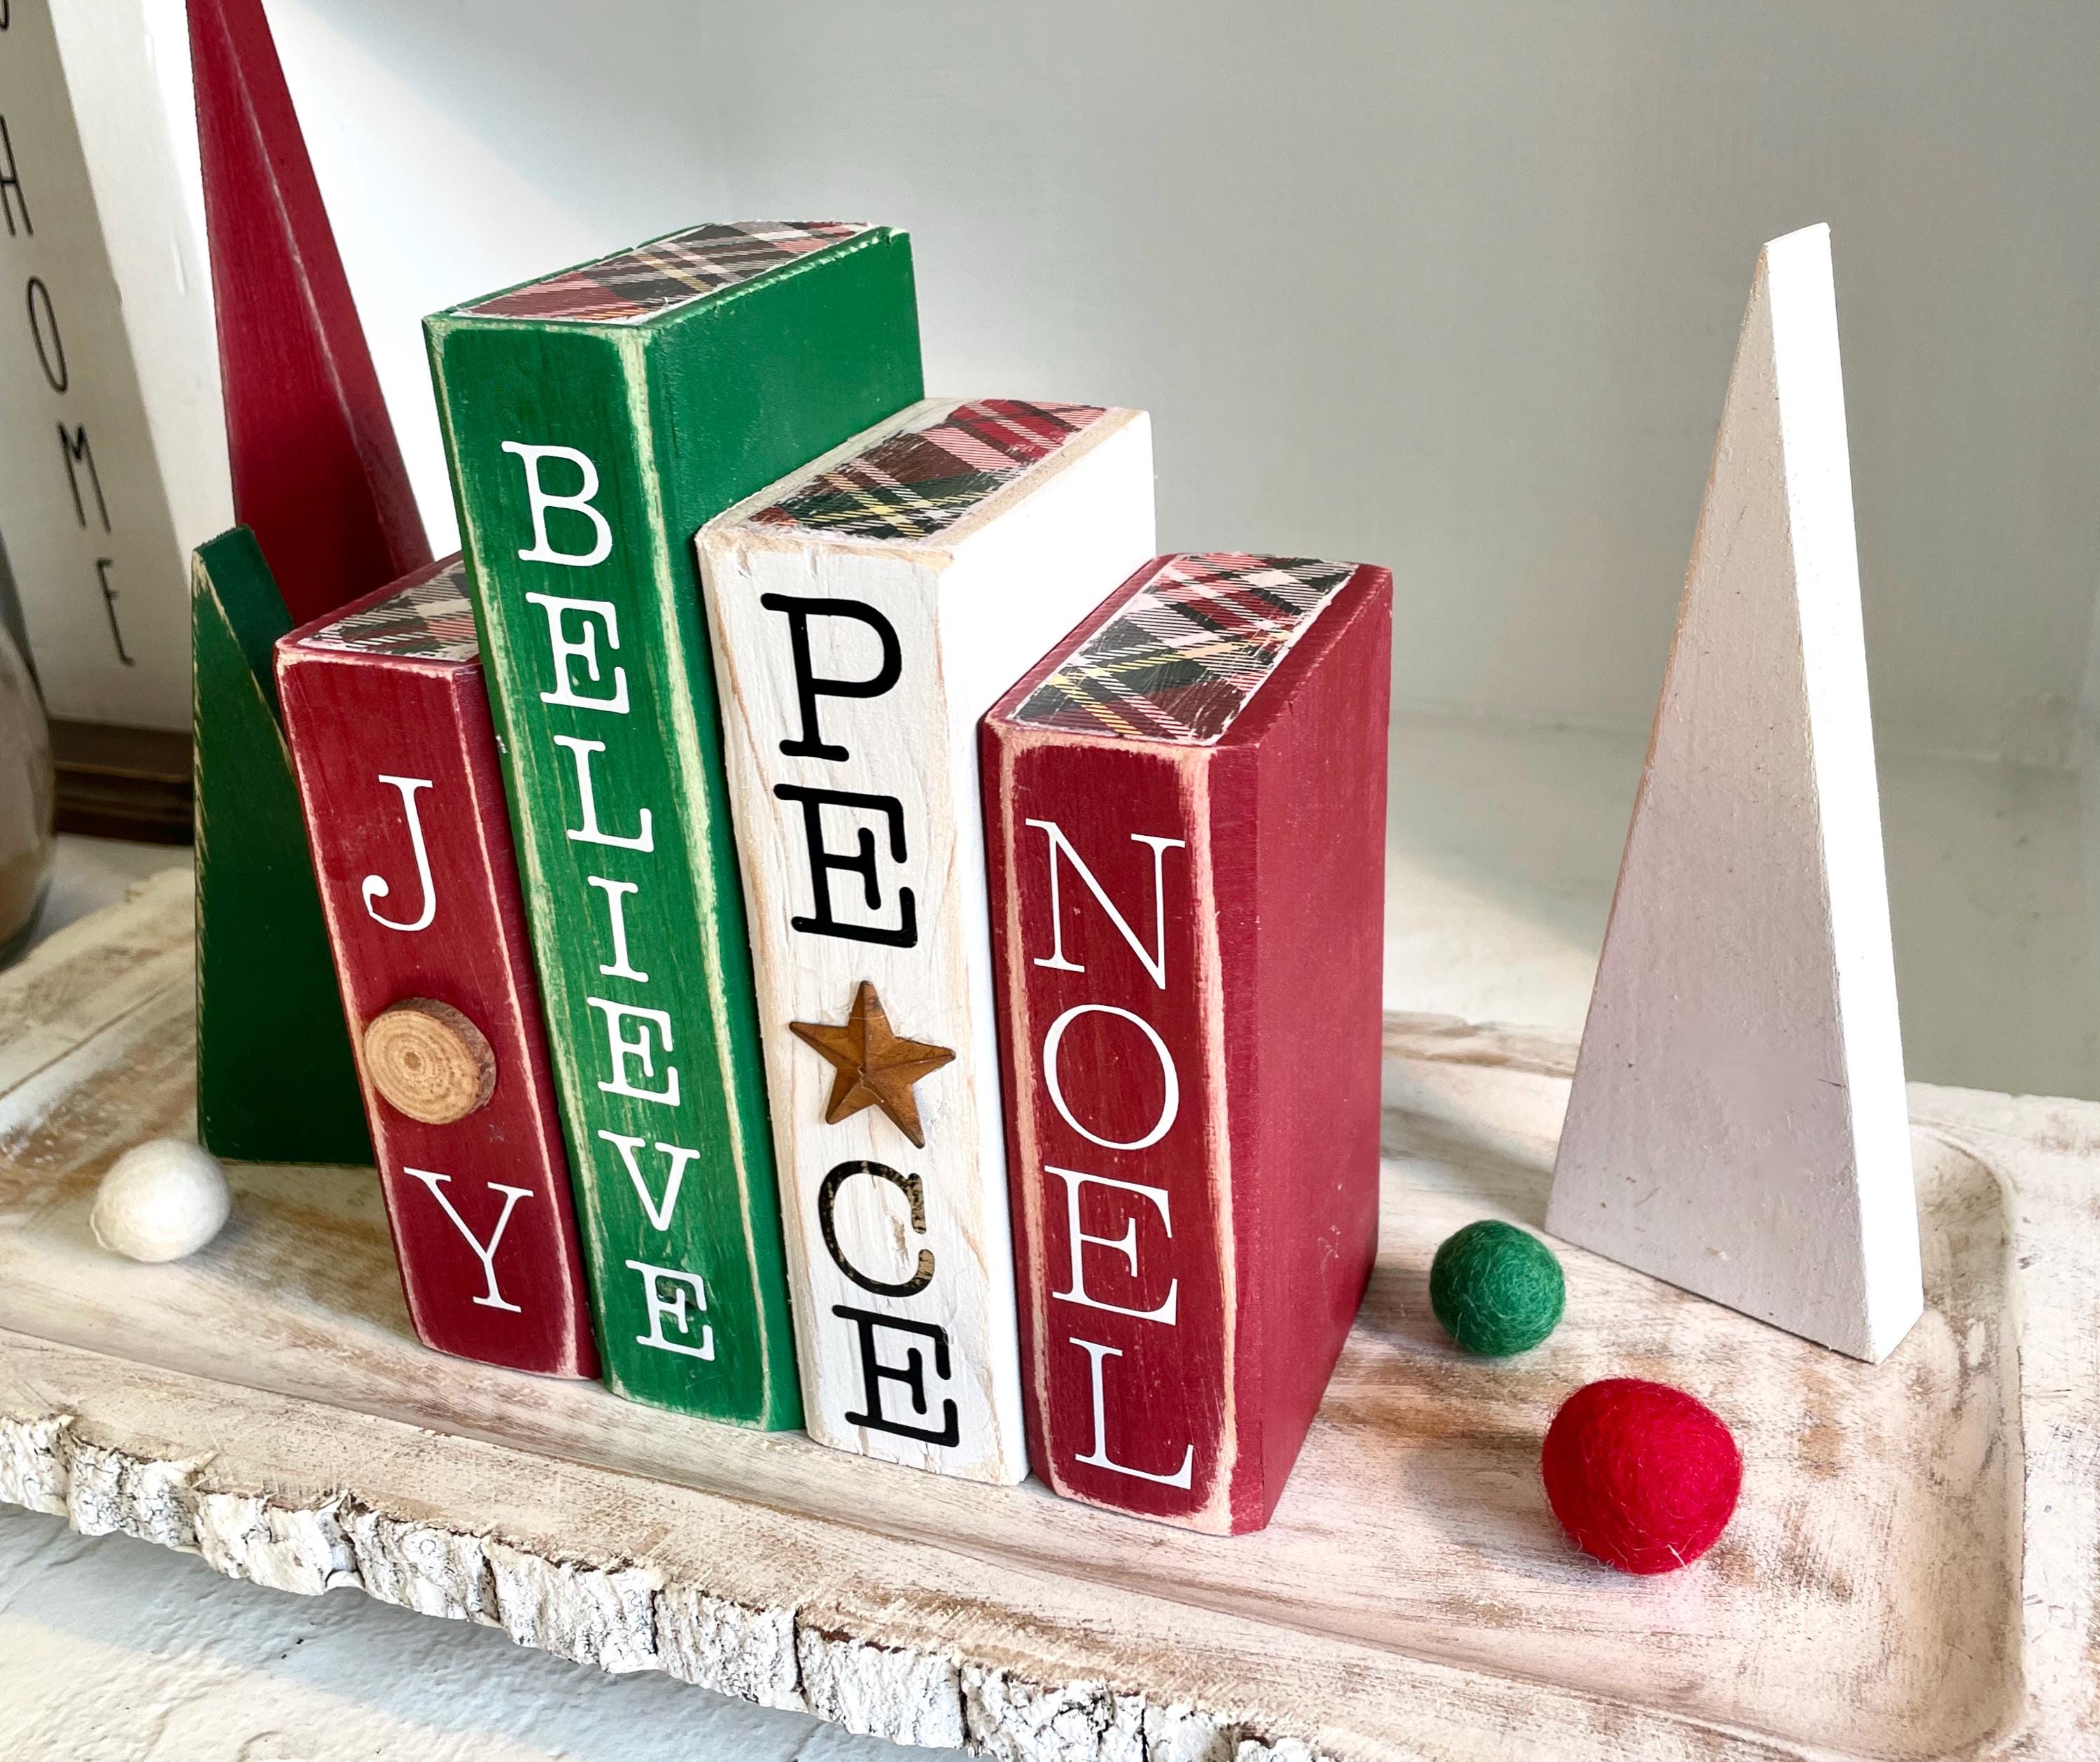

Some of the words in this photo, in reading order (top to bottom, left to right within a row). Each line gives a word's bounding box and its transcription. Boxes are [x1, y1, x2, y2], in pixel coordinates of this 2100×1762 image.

[362, 774, 533, 1313] JY
[502, 440, 715, 1361] BELIEVE
[761, 592, 960, 1448] PECE
[1026, 818, 1194, 1490] NOEL
